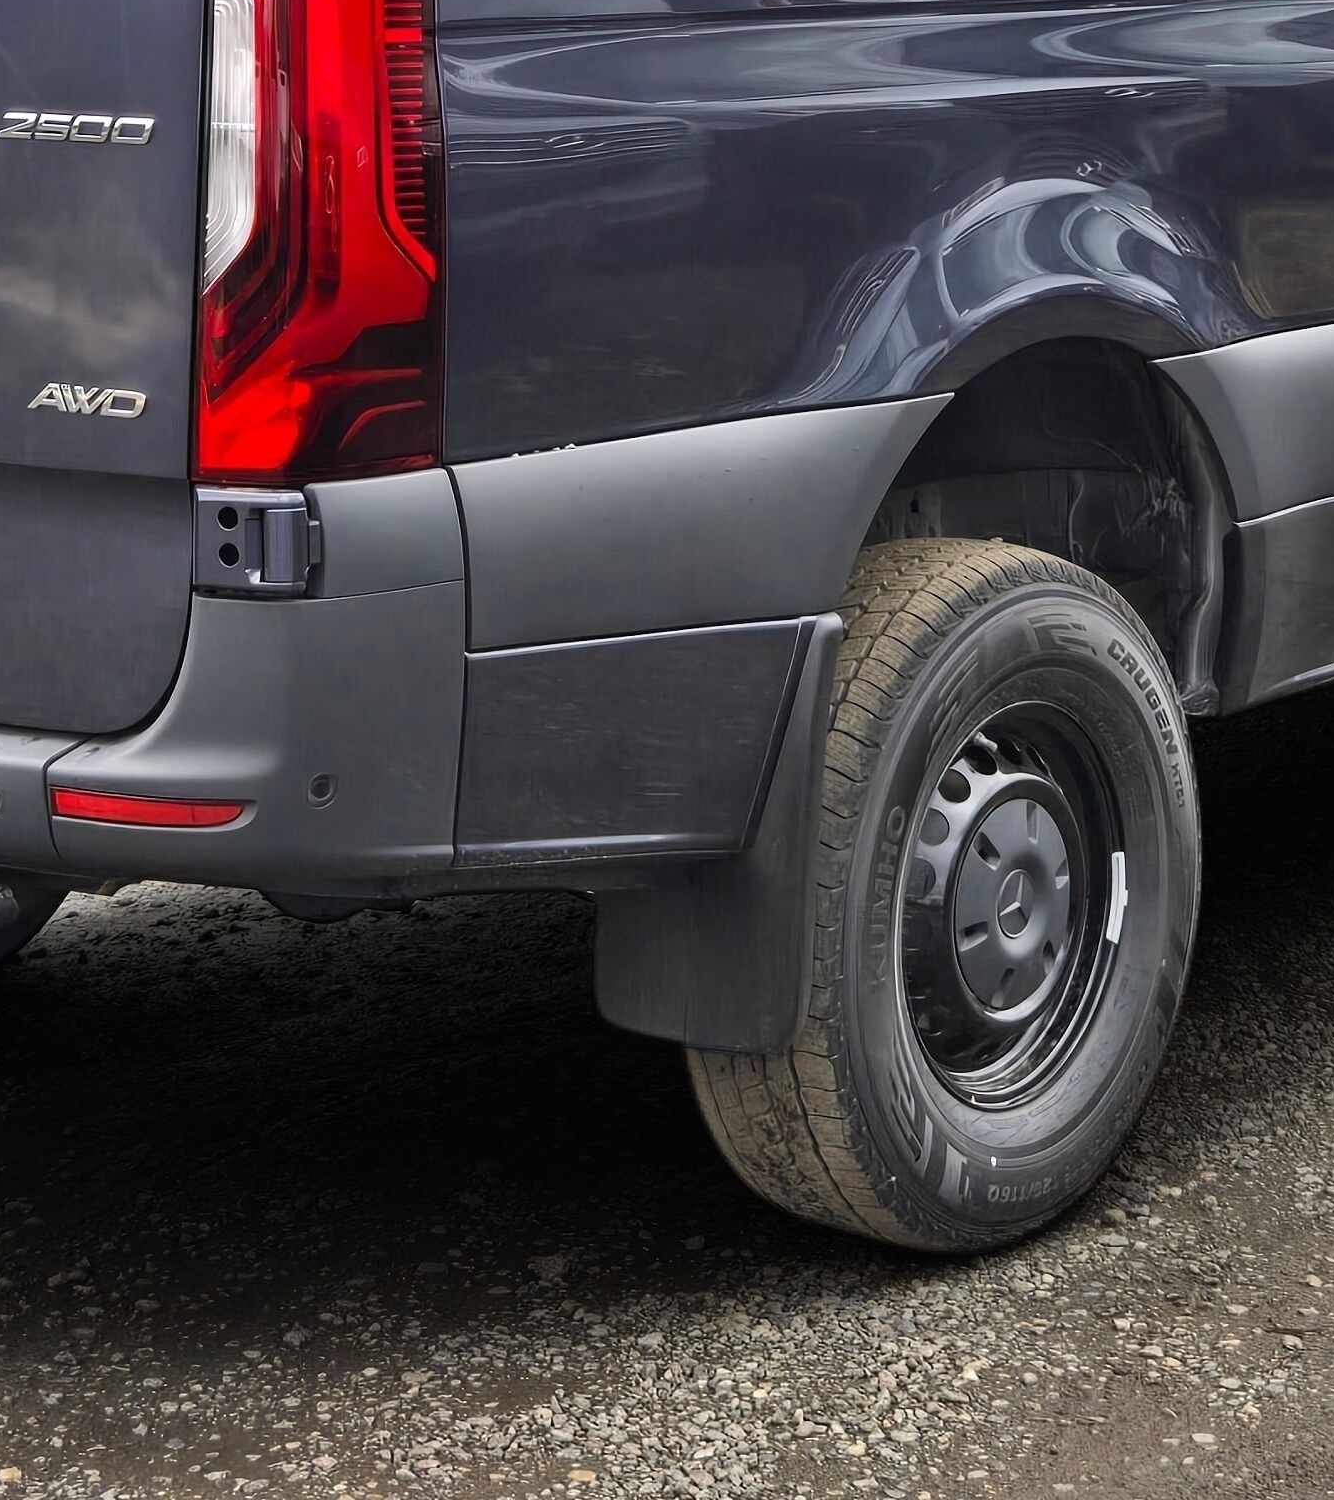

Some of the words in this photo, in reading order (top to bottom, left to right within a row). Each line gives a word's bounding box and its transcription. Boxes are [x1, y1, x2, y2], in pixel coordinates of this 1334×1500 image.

[27, 382, 148, 419] AWD
[1107, 638, 1178, 755] CRUGEN
[870, 805, 906, 986] KUMHO
